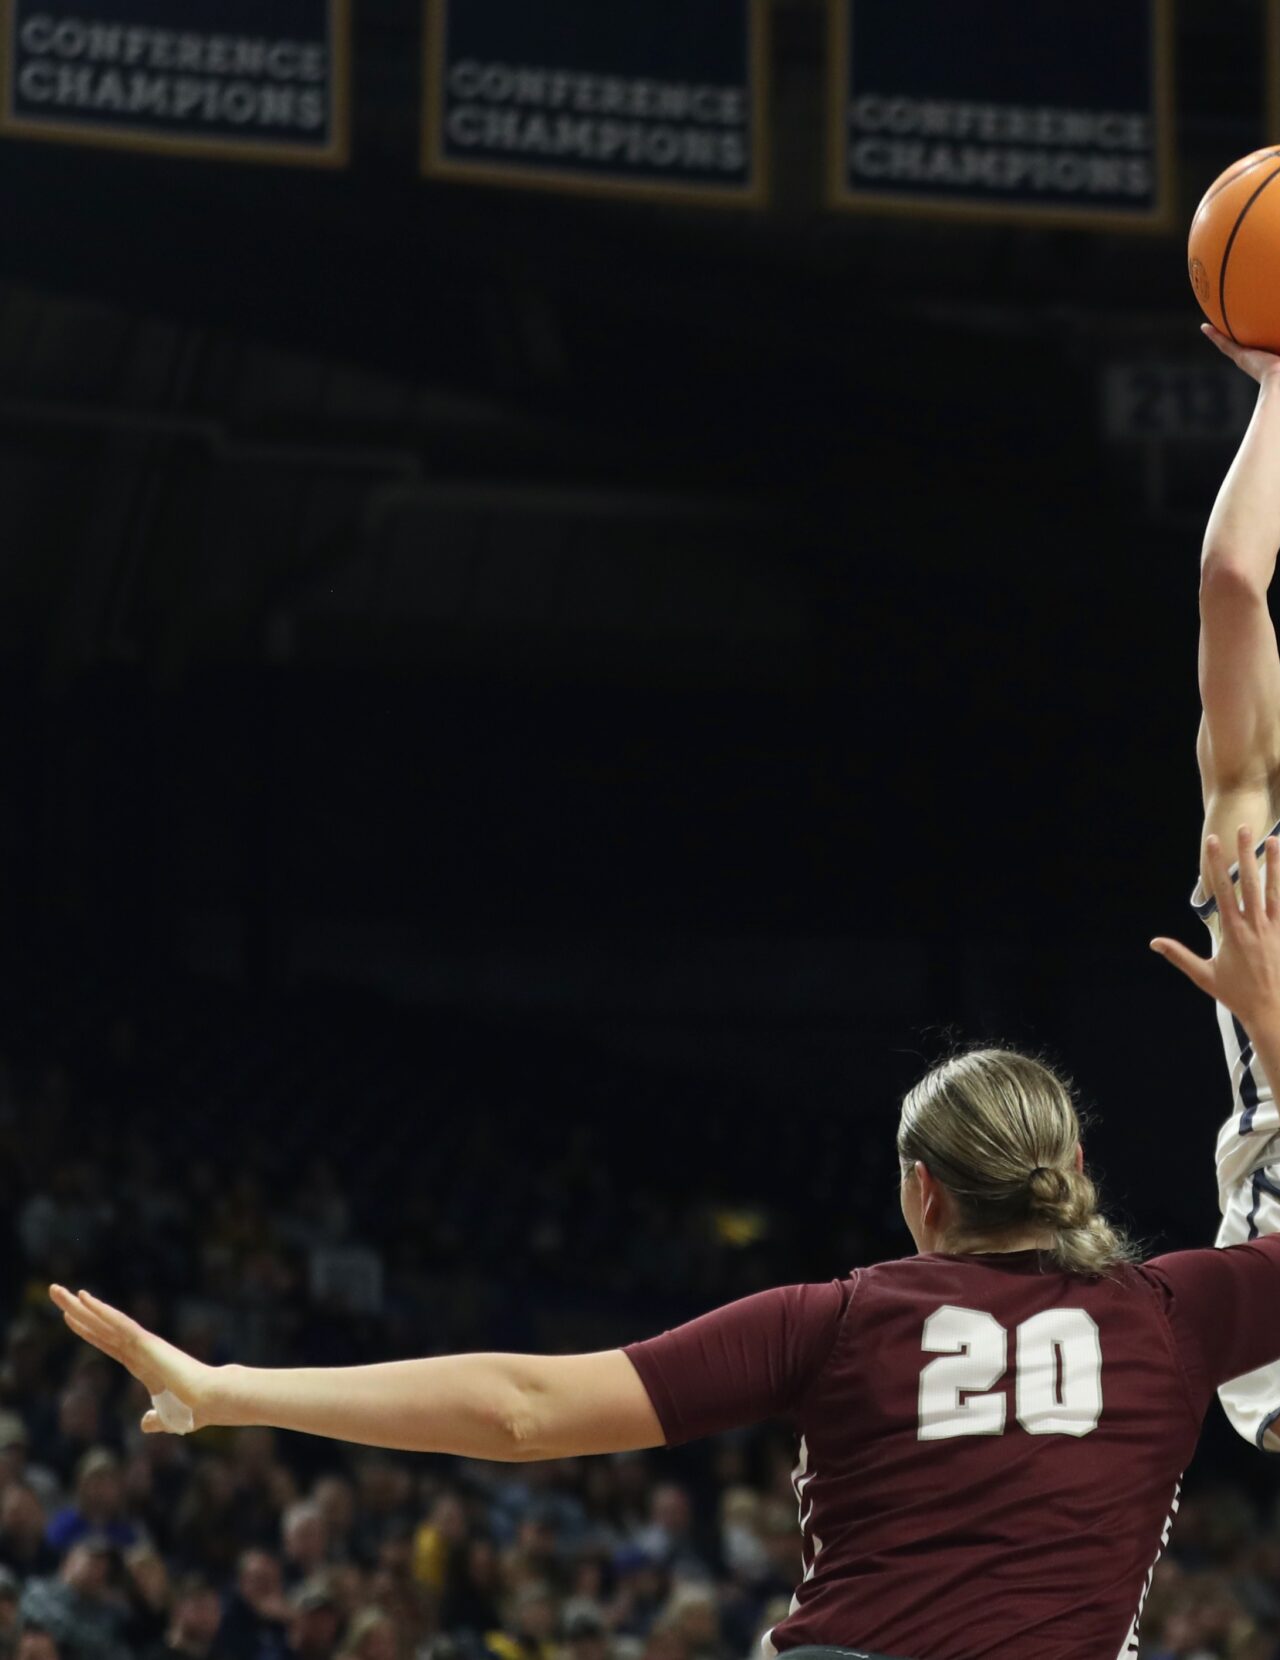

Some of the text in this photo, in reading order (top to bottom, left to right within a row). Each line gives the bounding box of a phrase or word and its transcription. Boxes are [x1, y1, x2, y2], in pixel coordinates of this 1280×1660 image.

[20, 15, 324, 81] CONFERENCE
[19, 59, 324, 130] CHAMPIONS
[449, 59, 742, 124] CONFERENCE
[852, 95, 1148, 149] CONFERENCE
[449, 104, 744, 171] CHAMPIONS
[853, 139, 1149, 195] CHAMPIONS
[917, 1305, 1104, 1441] 20
